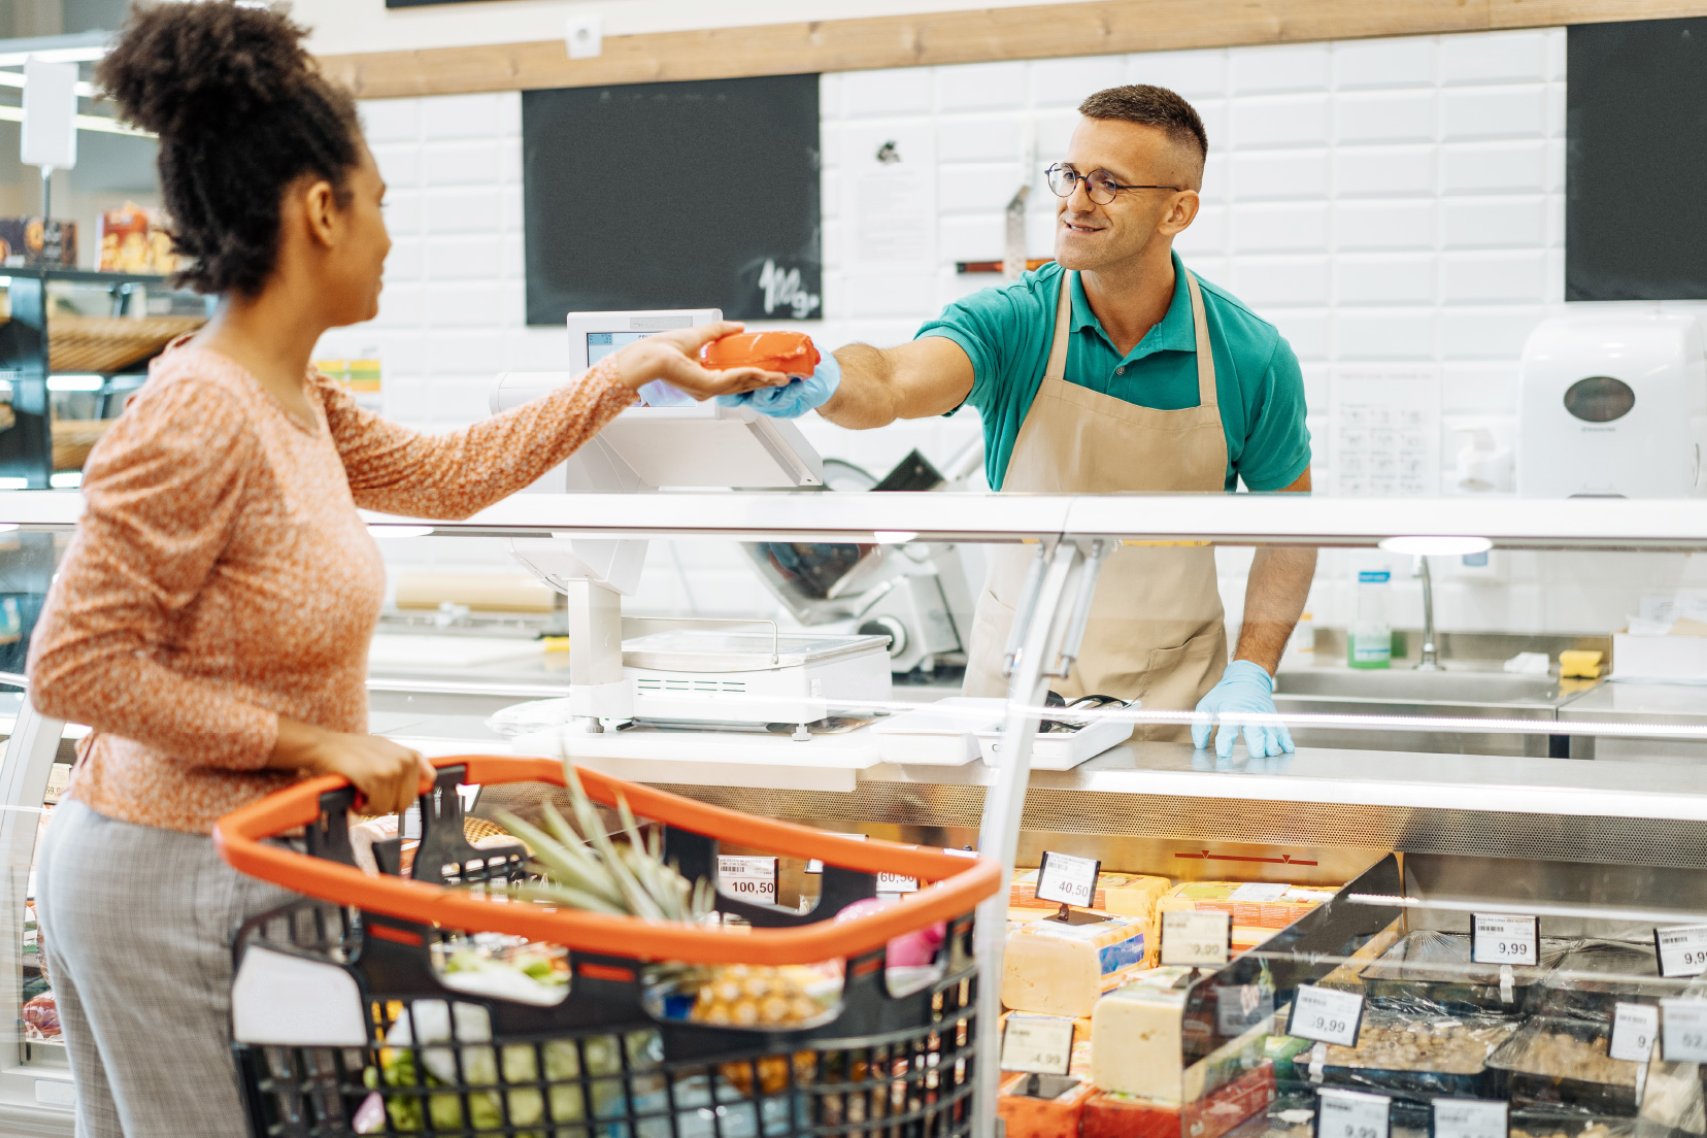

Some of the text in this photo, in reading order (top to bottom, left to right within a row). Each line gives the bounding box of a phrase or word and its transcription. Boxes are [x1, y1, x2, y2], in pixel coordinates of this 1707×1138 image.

[732, 881, 774, 895] 100,50
[1058, 880, 1089, 898] 40,50
[1498, 942, 1528, 956] 9,99
[1684, 951, 1707, 965] 9,9
[1316, 1017, 1346, 1034] 9,99
